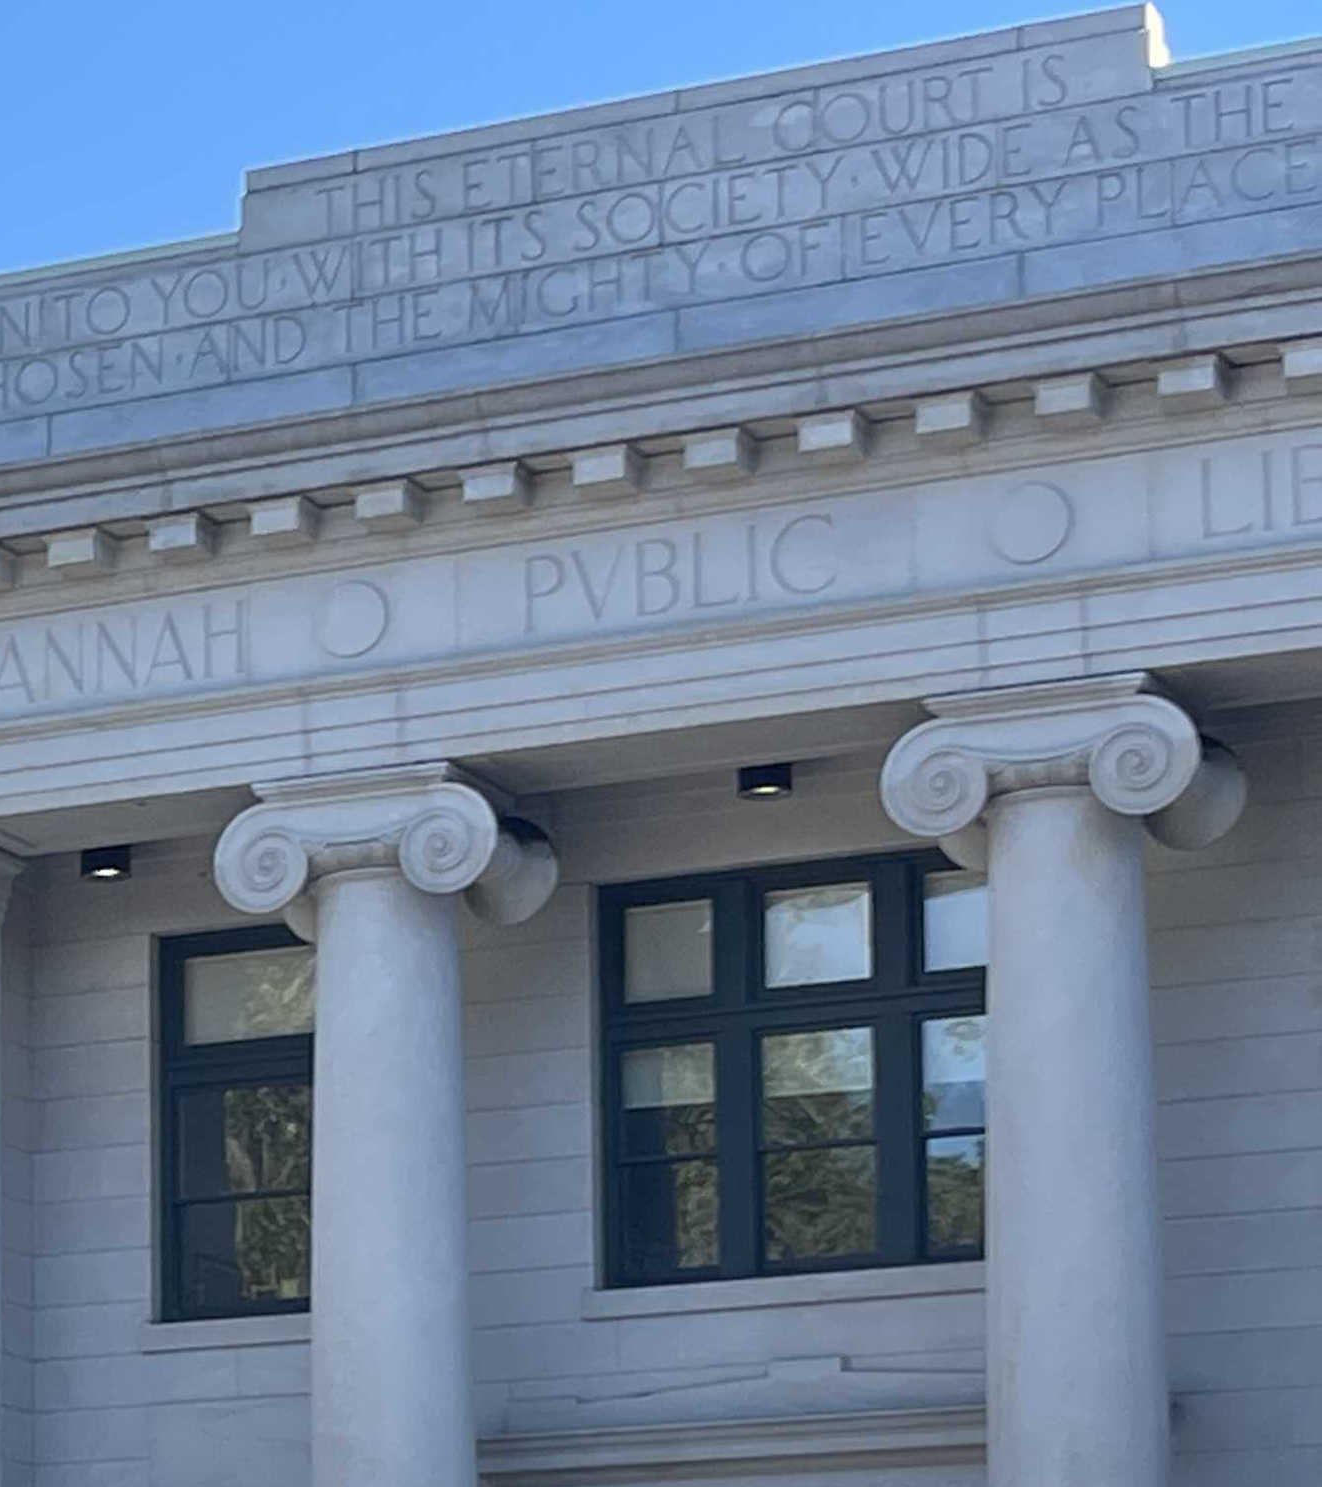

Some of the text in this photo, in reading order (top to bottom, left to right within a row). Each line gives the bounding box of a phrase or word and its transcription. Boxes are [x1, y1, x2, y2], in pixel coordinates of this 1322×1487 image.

[56, 285, 132, 342] TO
[150, 261, 272, 326] YOU
[292, 227, 445, 298] WITH
[464, 209, 547, 274] ITS
[574, 153, 845, 253] SOCIETY
[869, 122, 1036, 195] WIDE
[1063, 103, 1143, 169] AS
[1170, 77, 1295, 150] THE
[316, 53, 1070, 238] THIS ETERNAL COURT IS
[188, 313, 309, 381] AND
[332, 289, 443, 354] THE
[467, 239, 714, 335] MIGHTY
[739, 220, 833, 283] OF
[857, 176, 1071, 266] EVERY
[1094, 138, 1320, 229] PLACE
[521, 512, 839, 635] PVBLIC
